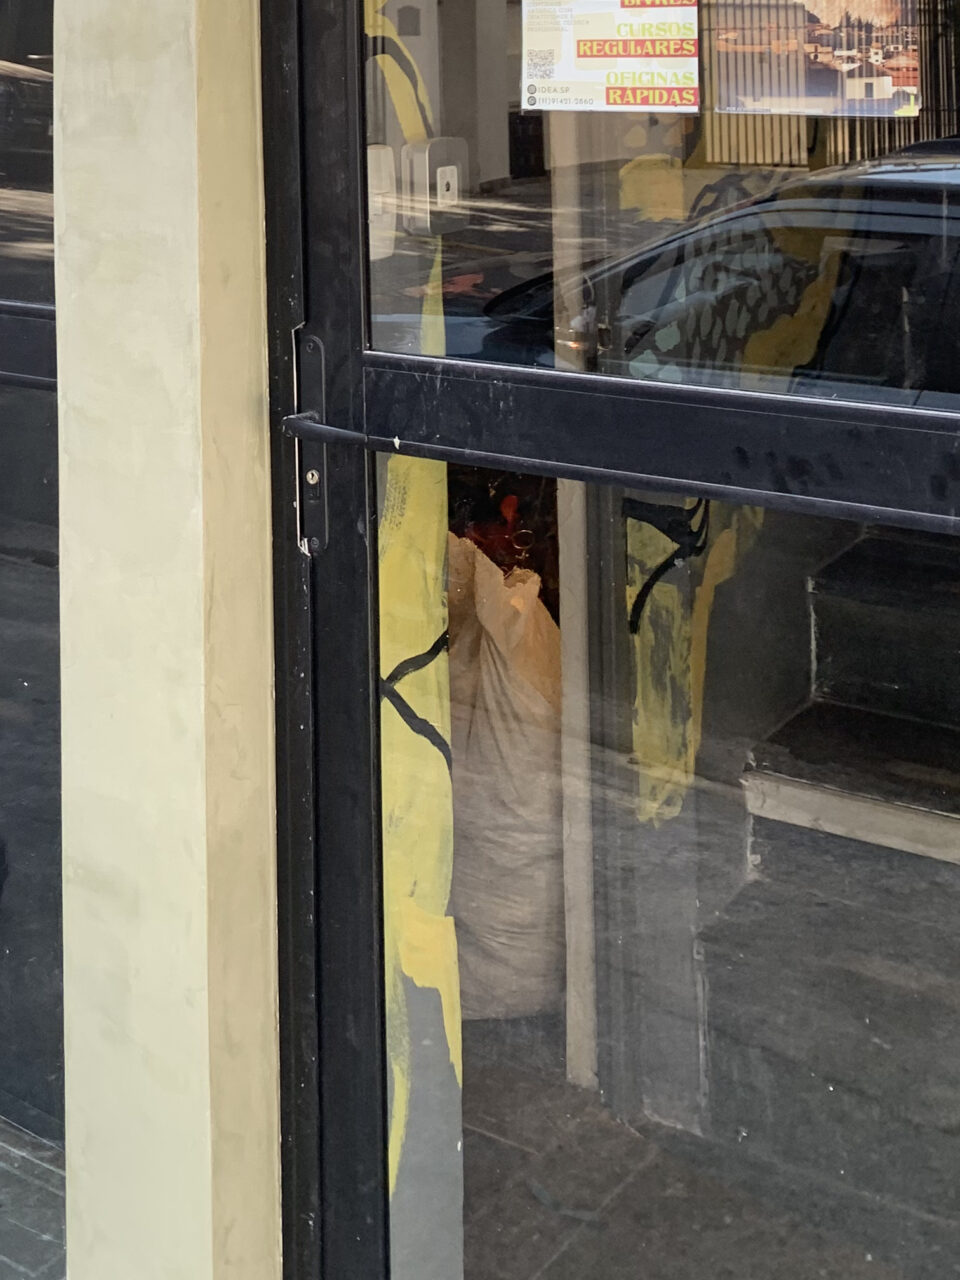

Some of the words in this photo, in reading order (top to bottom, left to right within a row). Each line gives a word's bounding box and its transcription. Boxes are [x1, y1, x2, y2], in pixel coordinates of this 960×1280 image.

[616, 21, 695, 38] CURSOS
[578, 39, 696, 57] REGULARES
[605, 70, 695, 87] OFICINAS
[608, 86, 695, 105] RÁPIDAS
